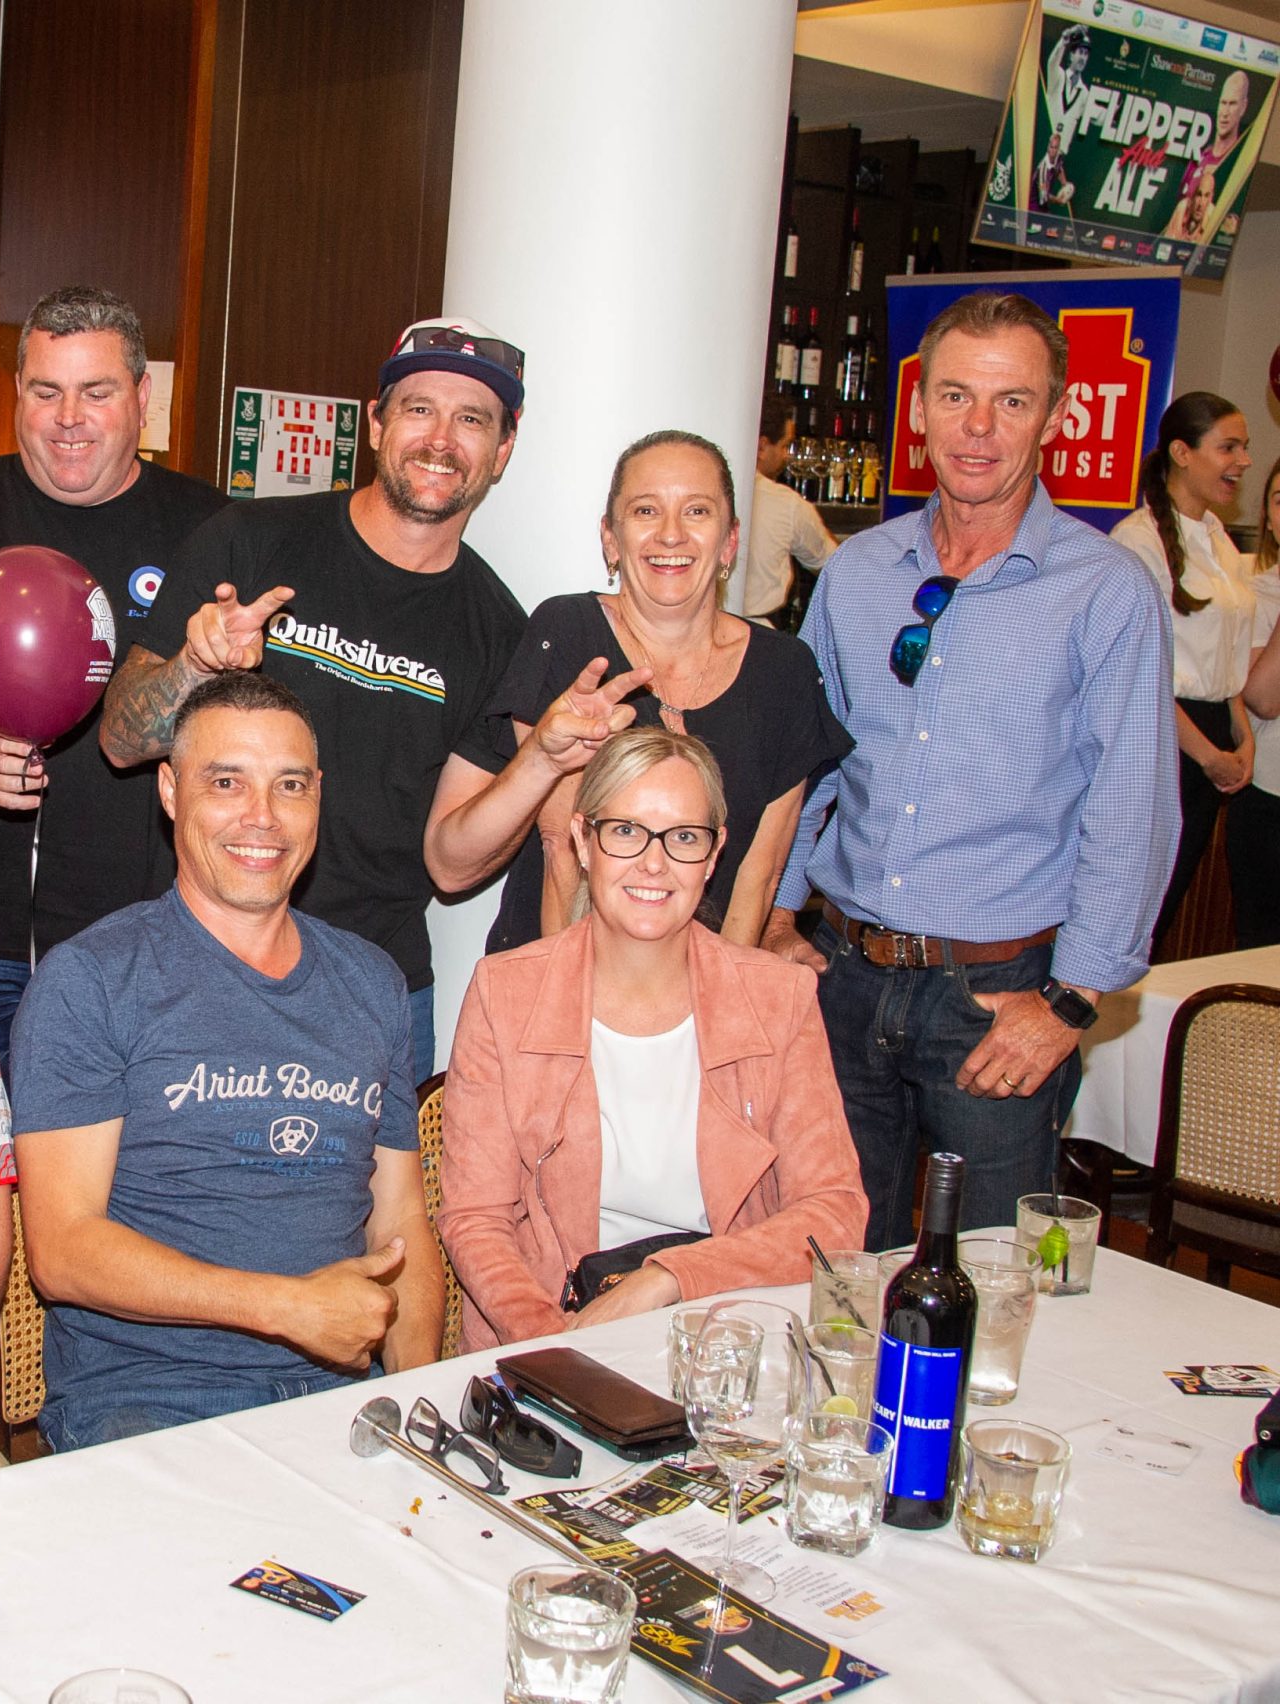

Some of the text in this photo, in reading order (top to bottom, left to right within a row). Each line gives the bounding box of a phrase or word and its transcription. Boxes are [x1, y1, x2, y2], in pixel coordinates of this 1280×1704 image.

[1078, 85, 1212, 163] FLIPPER
[1094, 158, 1168, 217] ALF
[269, 613, 425, 683] Quiksilver
[315, 662, 326, 671] The
[327, 667, 350, 681] Original
[164, 1063, 272, 1111] Ariat
[277, 1063, 359, 1106] Boot
[212, 1101, 315, 1113] AUTHENTIC
[903, 1414, 950, 1430] WALKER
